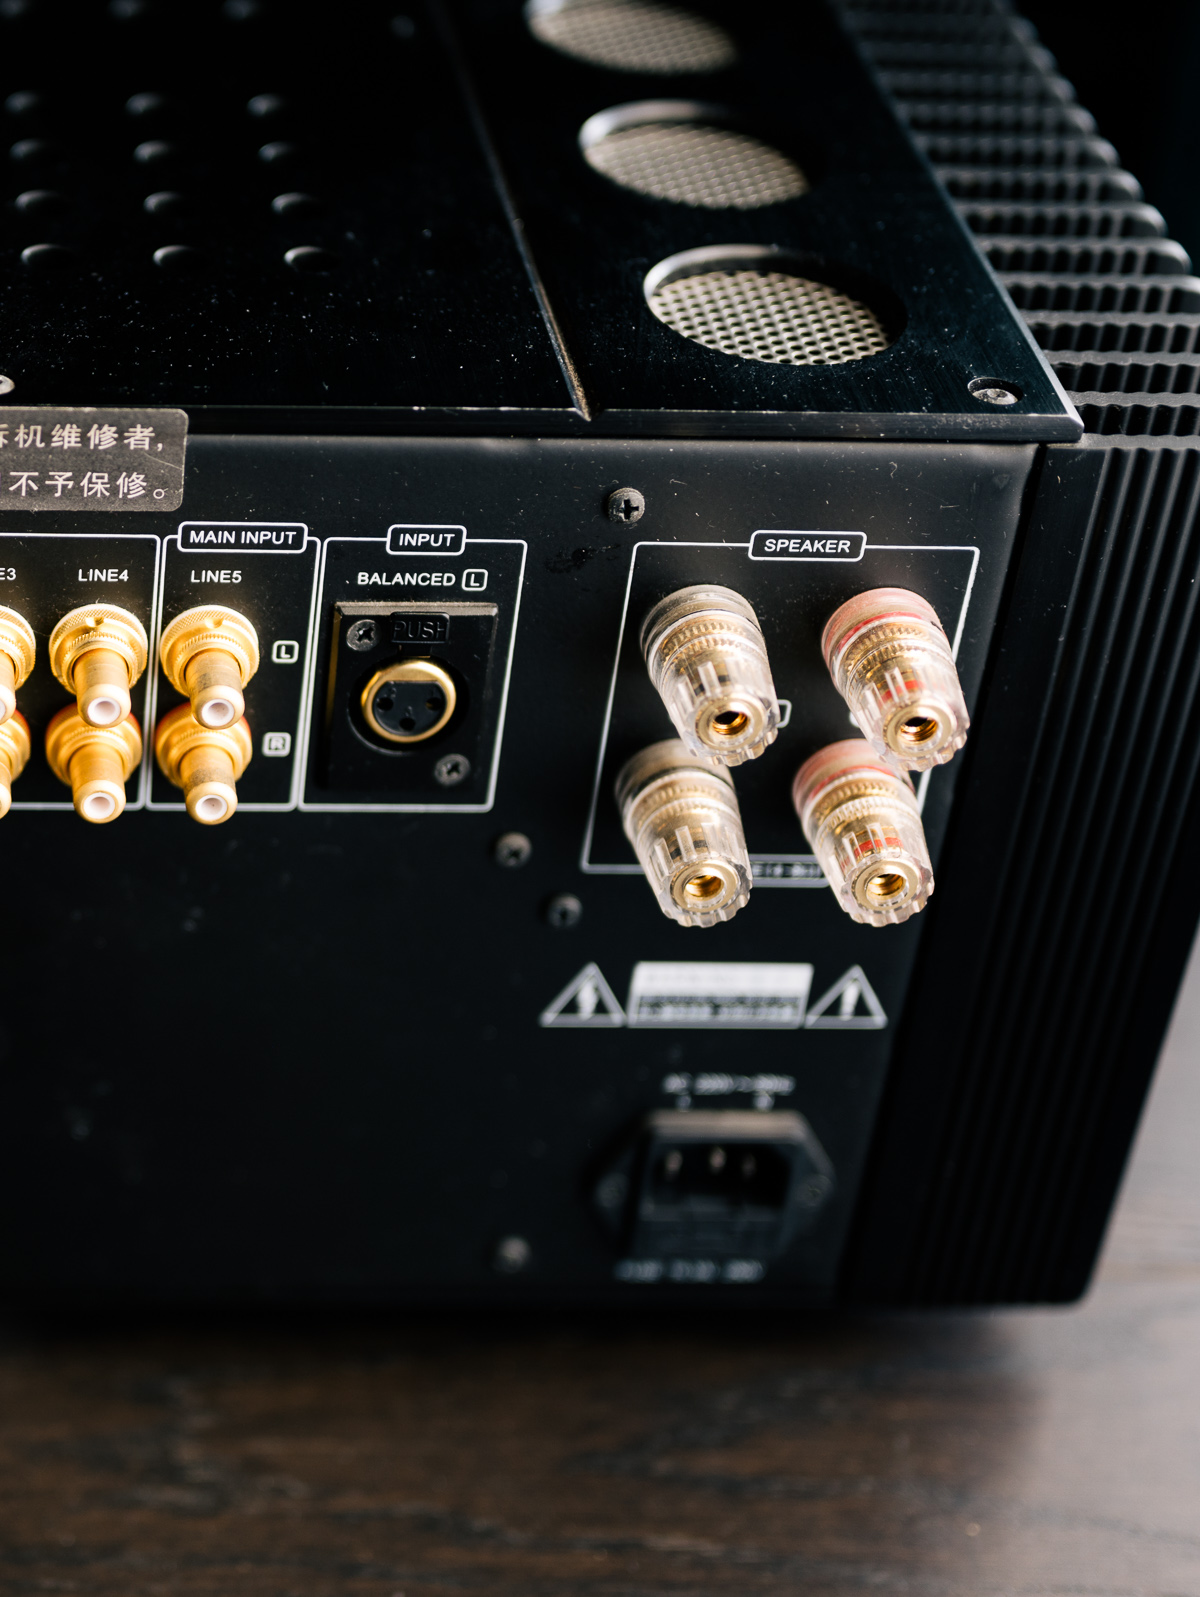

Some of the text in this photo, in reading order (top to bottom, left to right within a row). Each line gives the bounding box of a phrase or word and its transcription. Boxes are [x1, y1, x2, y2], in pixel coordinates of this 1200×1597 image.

[189, 530, 297, 545] MAIN INPUT
[398, 533, 455, 547] INPUT
[764, 538, 851, 554] SPEAKER
[77, 568, 130, 583] LINE4
[190, 569, 242, 584] LINE5
[357, 571, 480, 587] BALANCED L
[393, 620, 448, 639] PUSH
[280, 645, 291, 658] L
